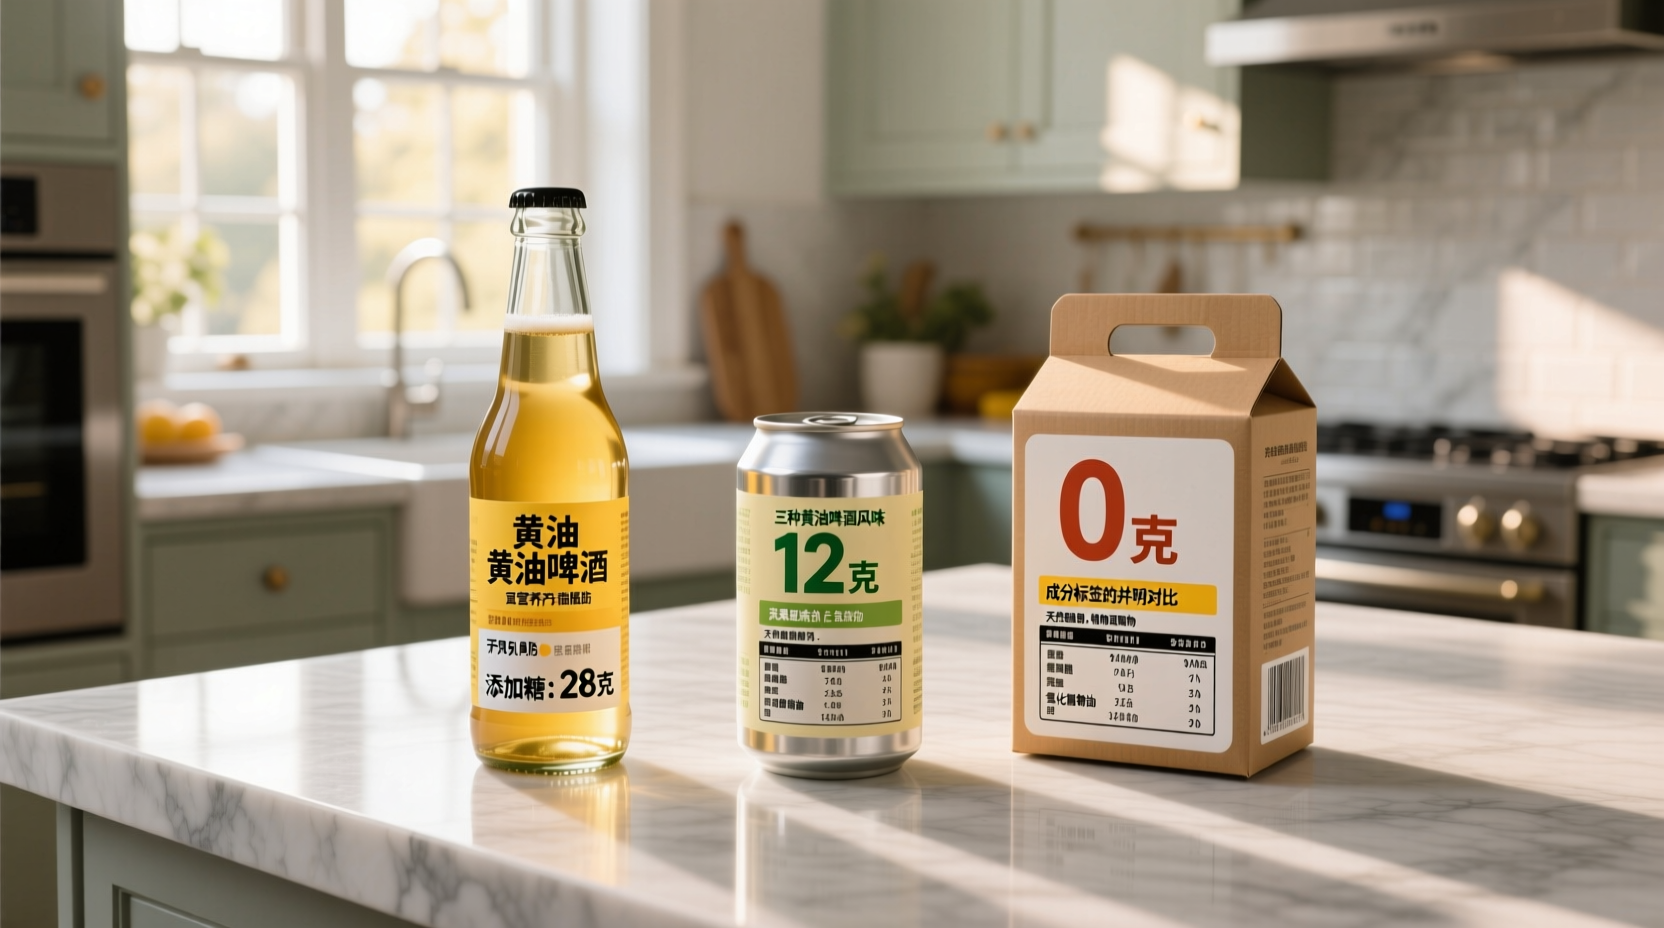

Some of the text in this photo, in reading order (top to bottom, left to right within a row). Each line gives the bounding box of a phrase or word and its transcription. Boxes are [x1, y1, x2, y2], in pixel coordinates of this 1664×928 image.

[513, 514, 579, 549] 黄油
[487, 549, 608, 586] 黄油啤酒
